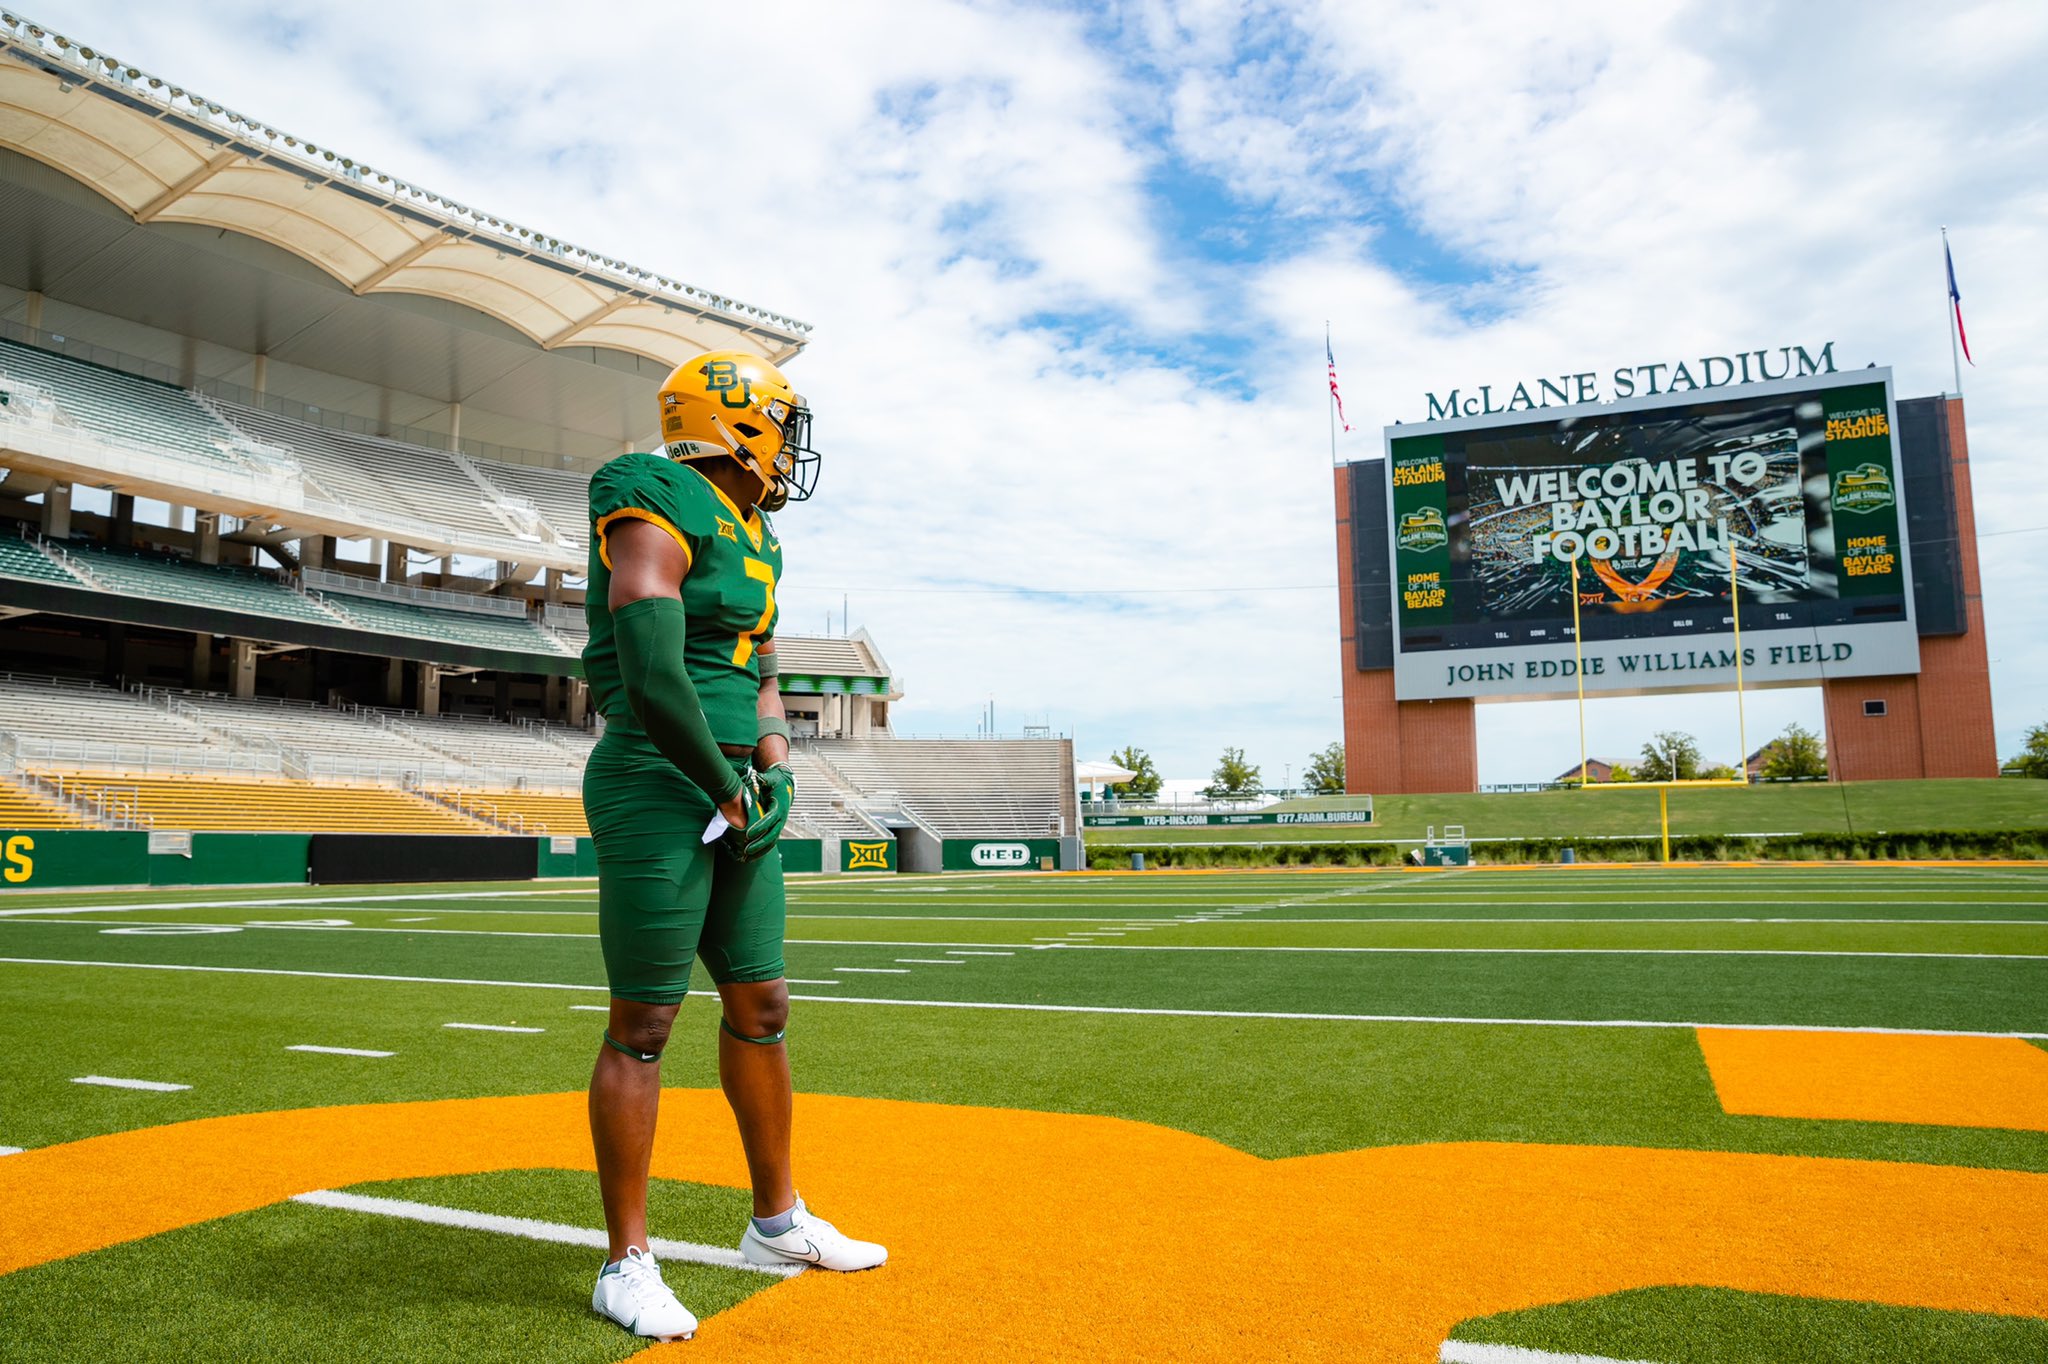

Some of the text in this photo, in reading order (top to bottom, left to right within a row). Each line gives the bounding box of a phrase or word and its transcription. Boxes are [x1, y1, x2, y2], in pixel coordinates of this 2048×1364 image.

[1425, 341, 1838, 421] McLANE STADIUM
[1829, 409, 1869, 420] WELCOME
[1826, 414, 1886, 431] McLANE
[1825, 424, 1889, 441] STADIUM
[1397, 457, 1429, 467] WELCOME
[1395, 463, 1443, 477] McLANE
[1393, 471, 1446, 487] STADIUM
[1495, 452, 1767, 506] WELCOME TO
[1551, 490, 1712, 531] BAYLOR
[1533, 518, 1738, 564] FOOTBALL
[1847, 535, 1887, 548] HOME
[1847, 546, 1887, 557] OF THE
[1843, 554, 1894, 567] BAYLOR
[1847, 564, 1892, 576] BEARS
[1408, 572, 1440, 584] HOME
[1408, 582, 1440, 591] OF THE
[1404, 588, 1446, 601] BAYLOR
[1407, 598, 1443, 609] BEARS
[732, 556, 775, 667] 7
[1447, 643, 1853, 686] JOHN EDDIE WILLIAMS FIELD
[1143, 815, 1207, 826] TXFB-INS.COM
[1276, 812, 1366, 824] 877.FARM.BUREAU
